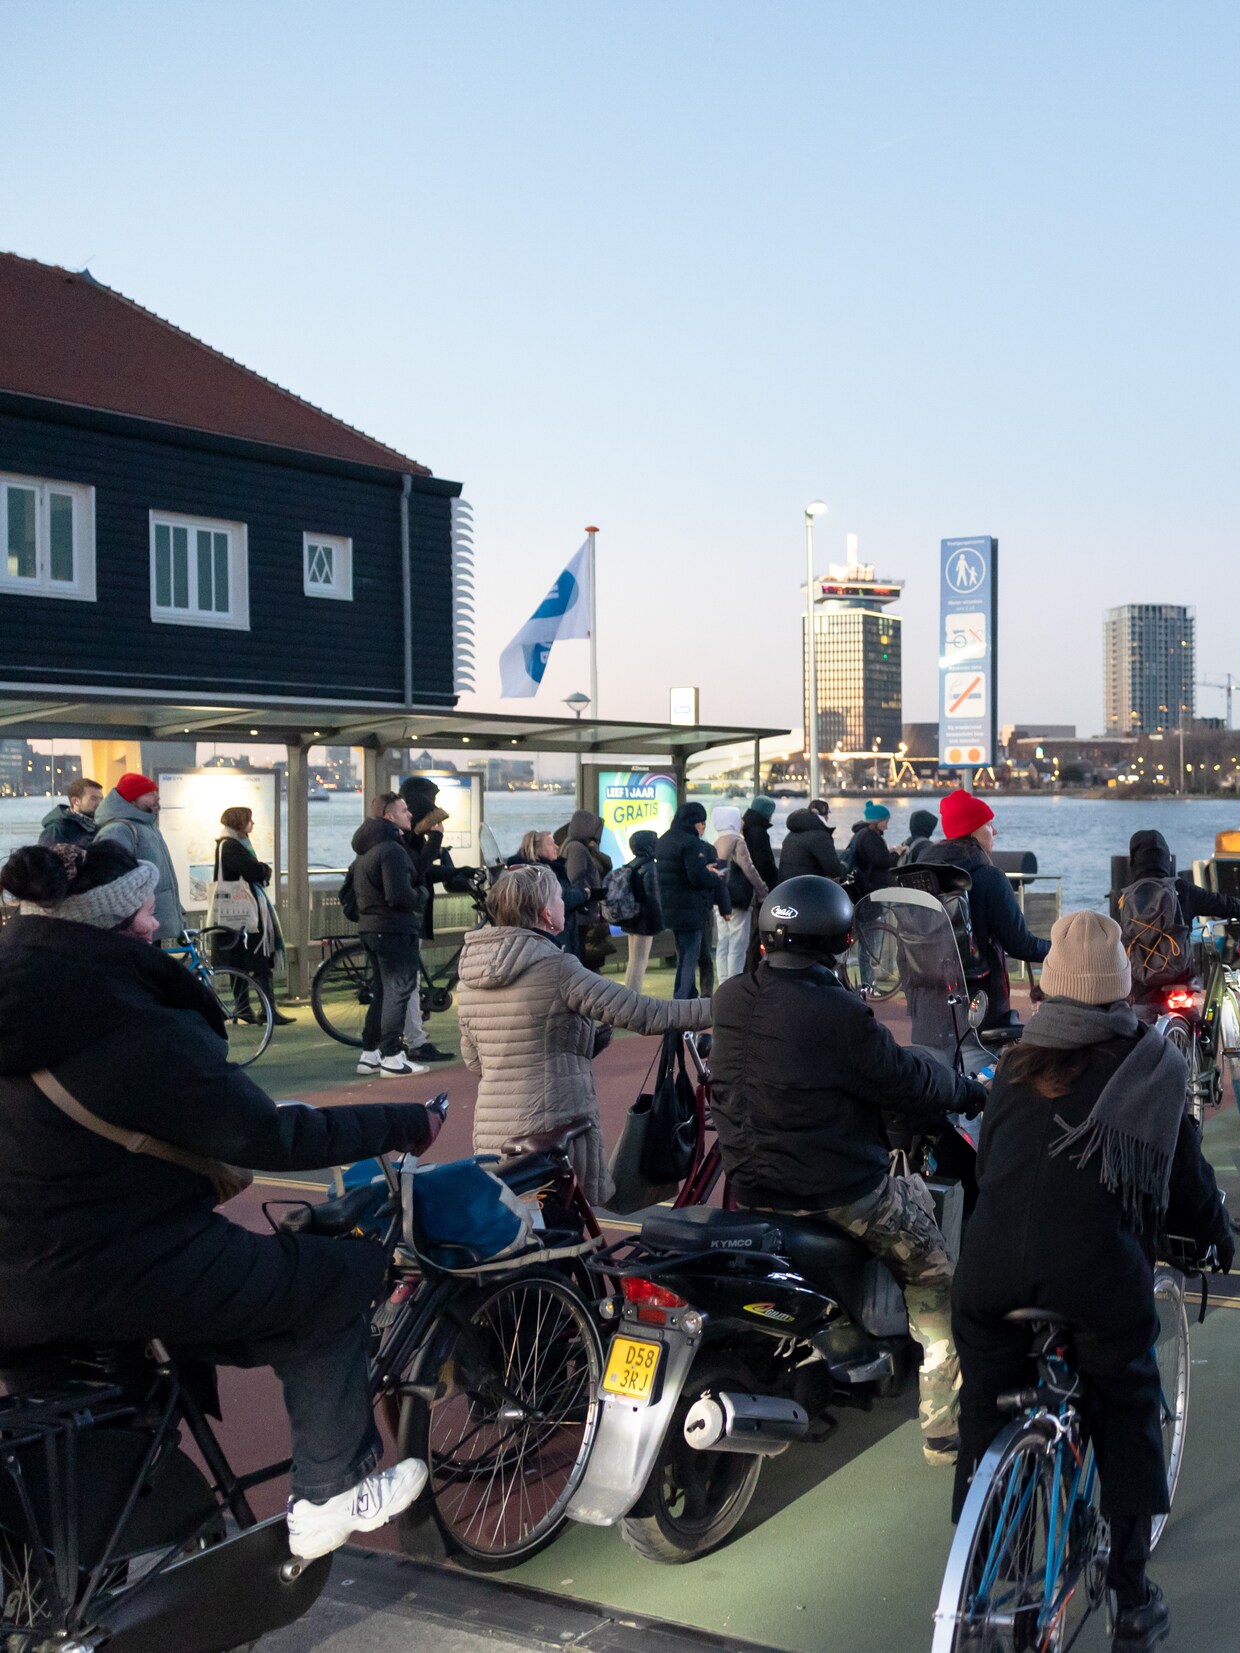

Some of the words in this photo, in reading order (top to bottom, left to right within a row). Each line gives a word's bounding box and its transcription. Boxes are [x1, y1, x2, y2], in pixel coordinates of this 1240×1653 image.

[606, 787, 625, 798] LEEF
[630, 787, 654, 798] JAAR
[613, 802, 658, 823] GRATIS
[711, 1239, 753, 1248] KYMCO
[625, 1345, 655, 1368] D58
[620, 1369, 648, 1391] 3RJ
